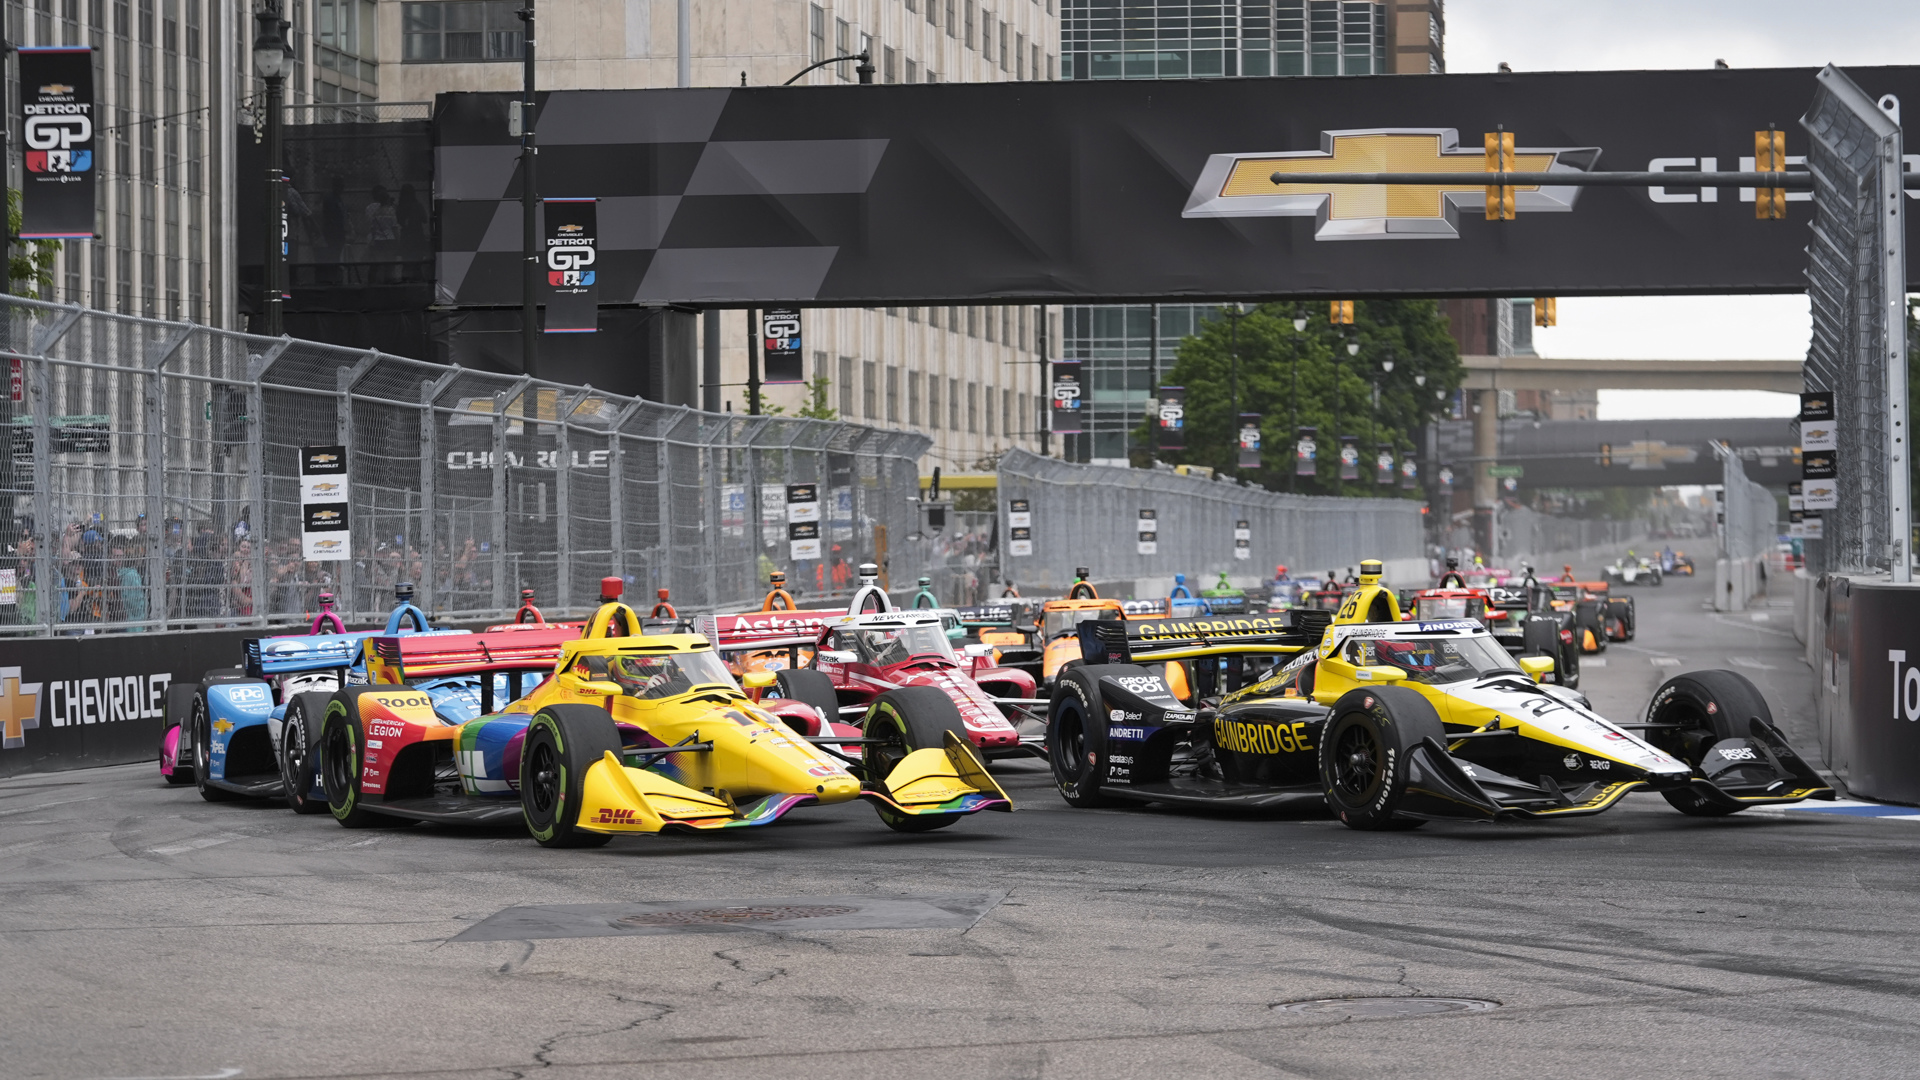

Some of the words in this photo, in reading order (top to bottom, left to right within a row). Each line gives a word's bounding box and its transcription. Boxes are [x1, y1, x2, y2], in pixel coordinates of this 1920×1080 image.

[24, 103, 91, 115] DETROIT
[25, 114, 92, 150] GP
[547, 238, 595, 246] DETROIT
[548, 246, 595, 270] GP
[765, 319, 800, 338] GP
[1054, 386, 1081, 400] GP
[1339, 591, 1362, 619] 26
[1139, 617, 1288, 641] GAINBRIDGE
[1119, 675, 1161, 686] GROUP
[579, 687, 600, 695] DHL
[1060, 679, 1089, 708] Firestone
[50, 672, 172, 728] CHEVROLET
[377, 696, 430, 708] Root
[1125, 711, 1143, 721] Select
[368, 724, 403, 738] LEGION
[1109, 727, 1144, 739] ANDRETTI
[1214, 717, 1314, 755] GAINBRIDGE
[1373, 747, 1396, 812] Firestone
[599, 808, 636, 825] DHL
